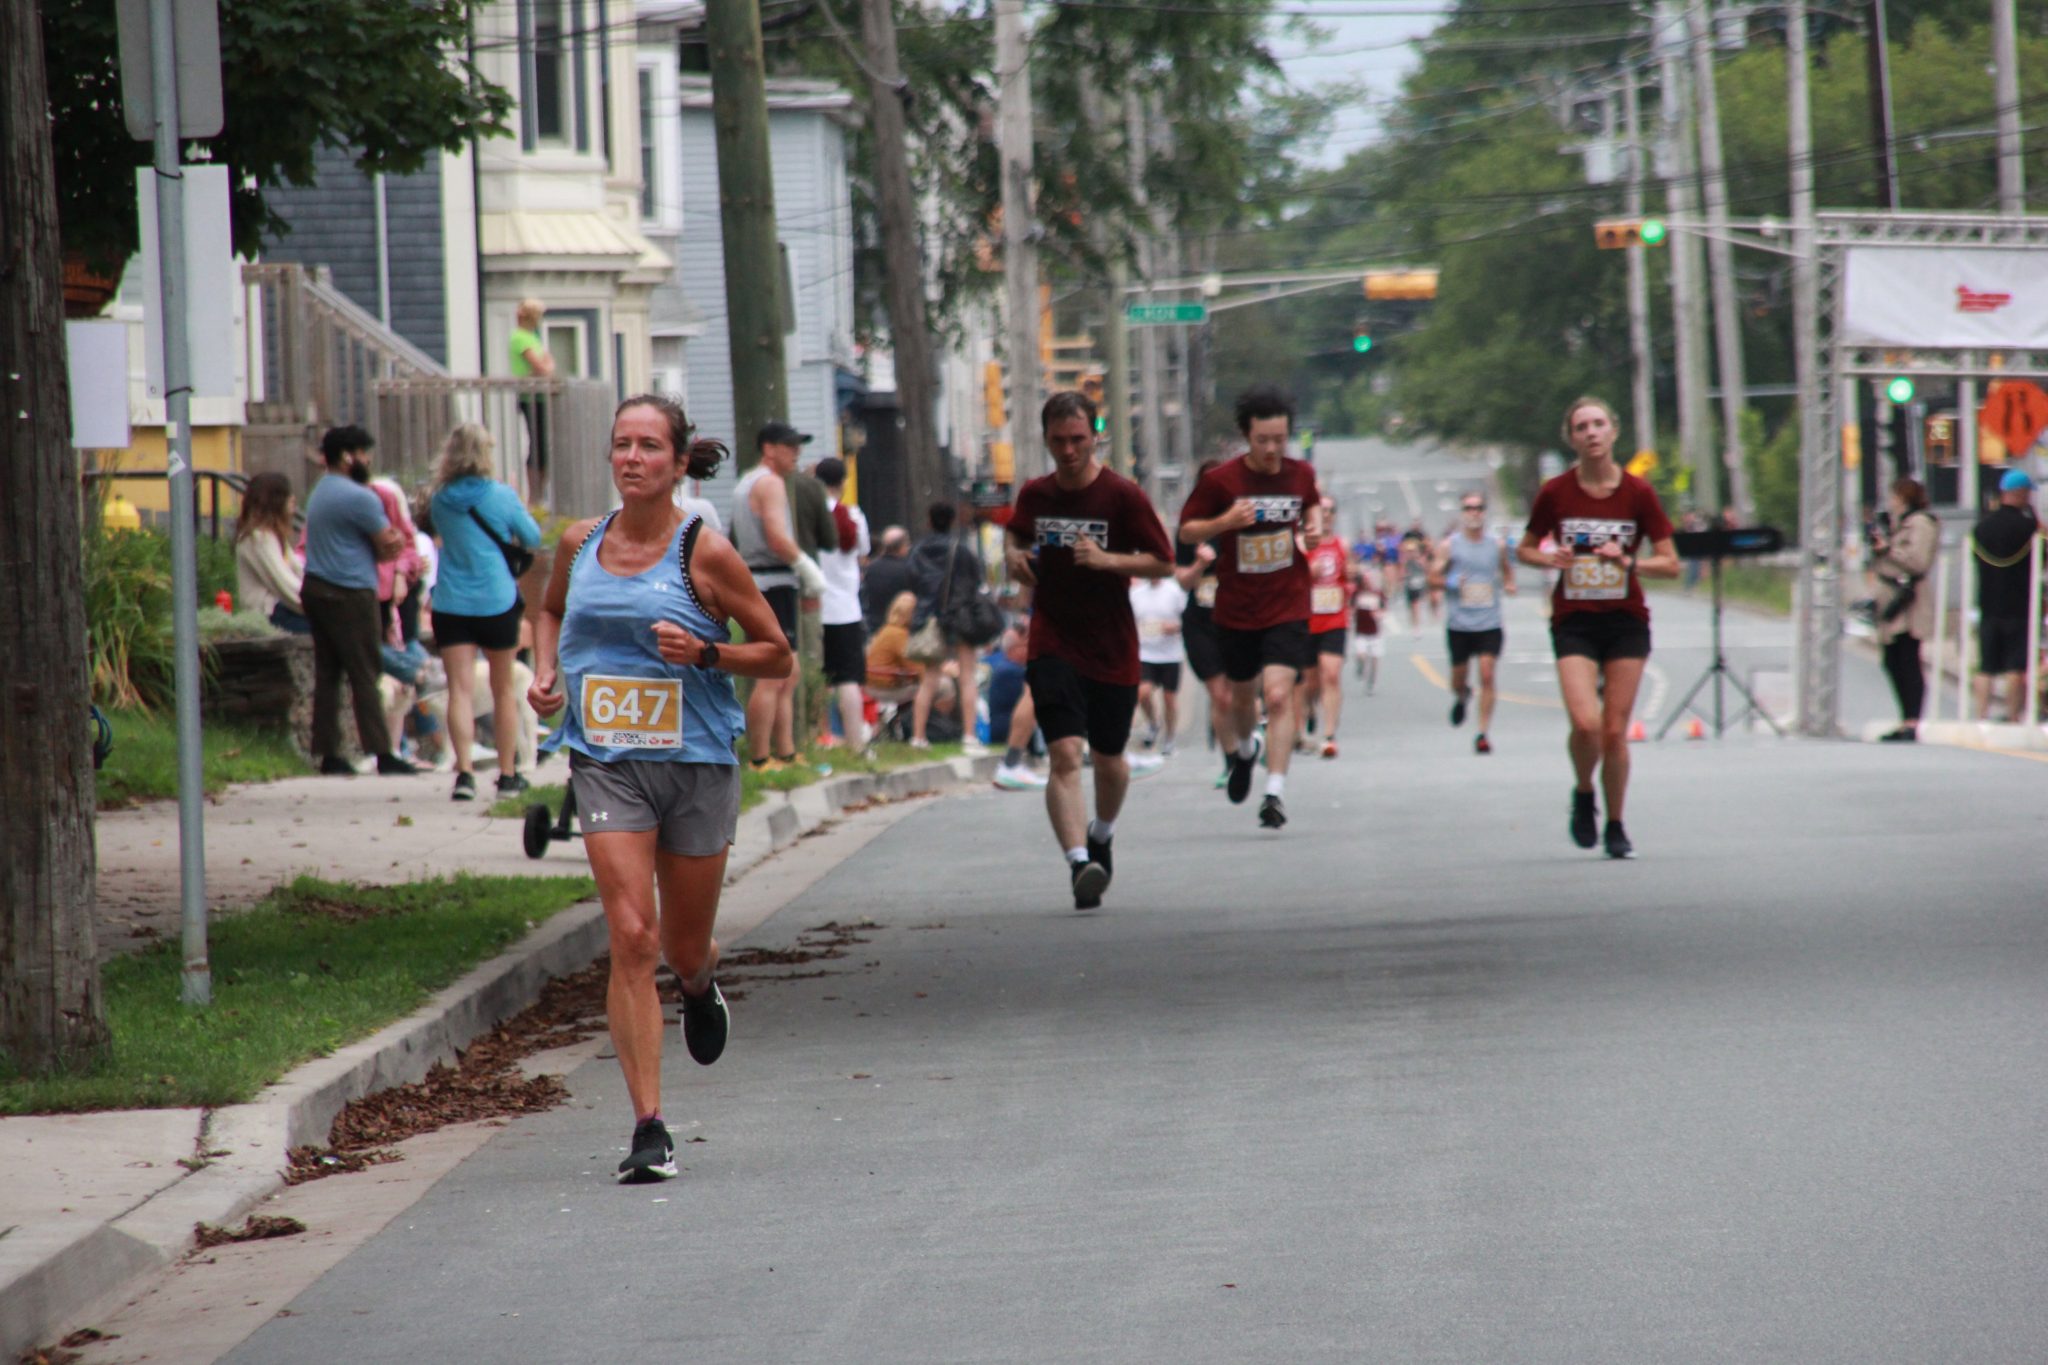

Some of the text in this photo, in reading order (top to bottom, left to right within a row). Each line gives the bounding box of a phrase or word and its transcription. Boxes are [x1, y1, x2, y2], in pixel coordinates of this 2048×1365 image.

[1245, 540, 1288, 562] 519
[1571, 561, 1620, 586] 635
[591, 686, 669, 726] 647
